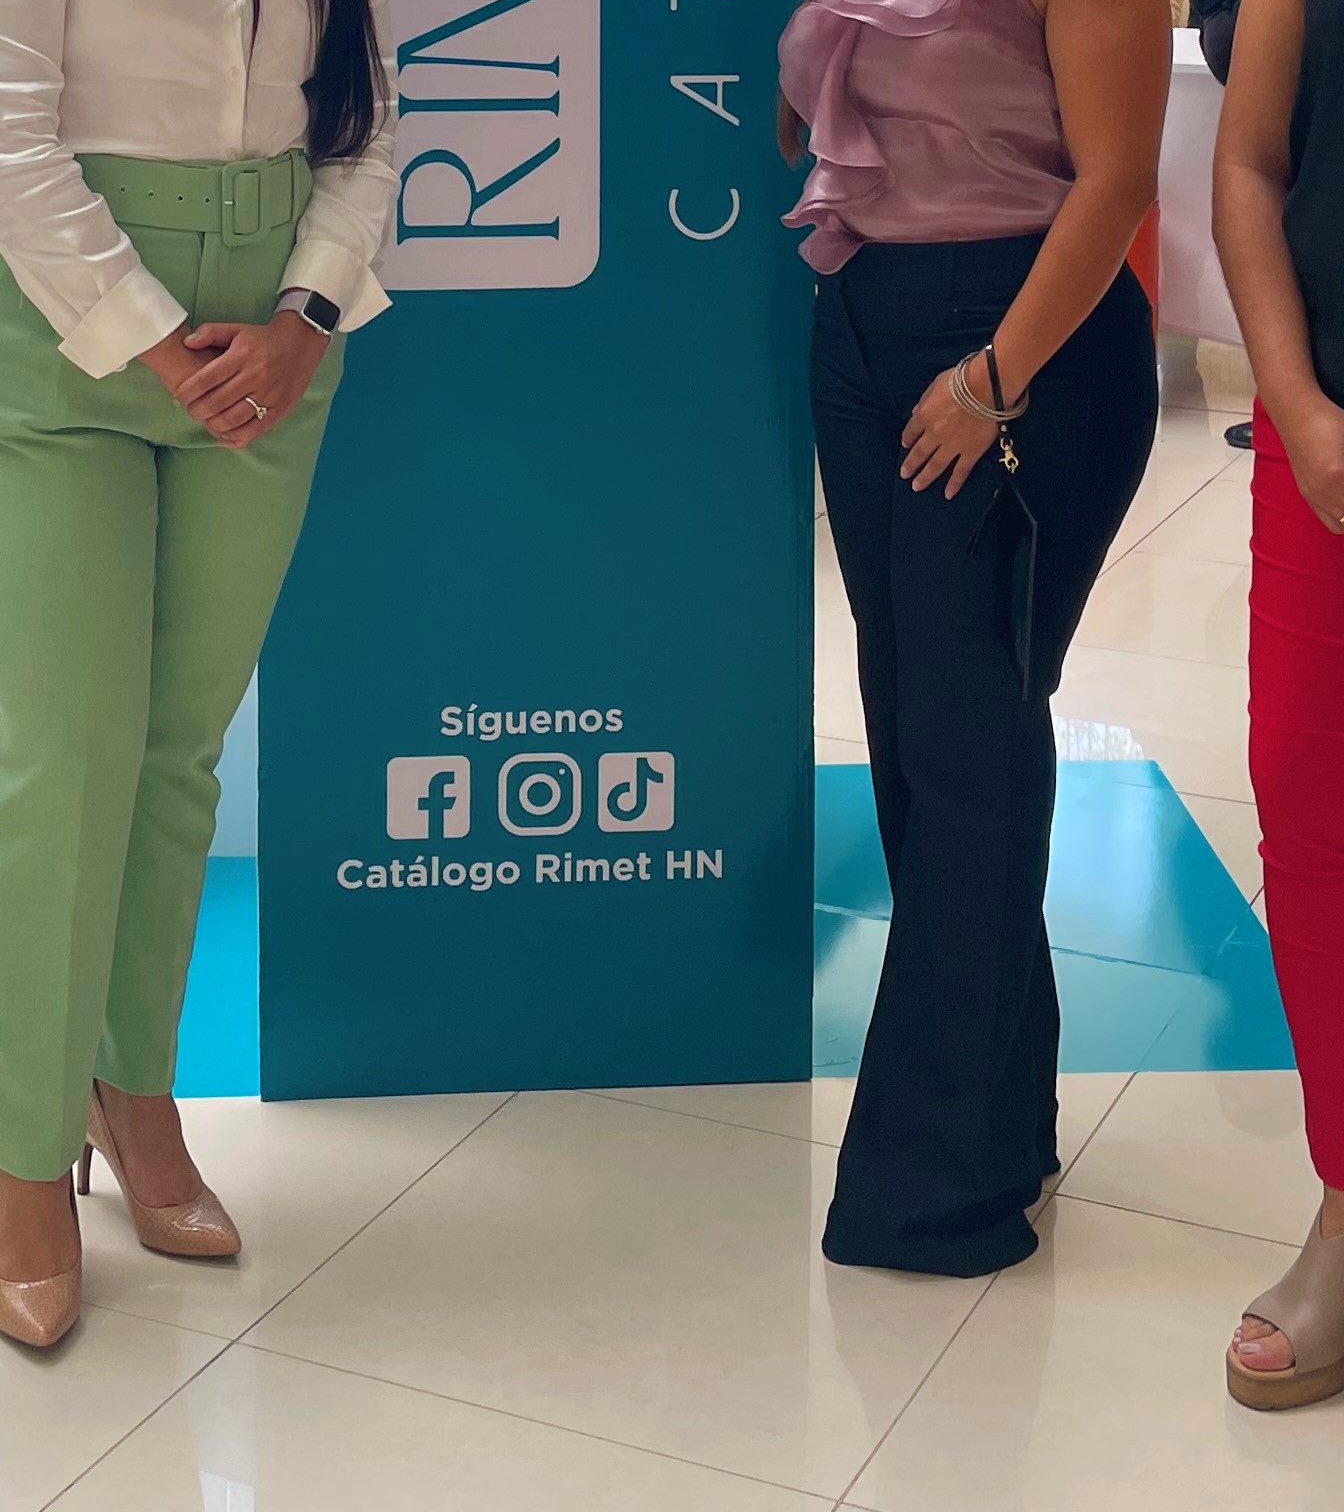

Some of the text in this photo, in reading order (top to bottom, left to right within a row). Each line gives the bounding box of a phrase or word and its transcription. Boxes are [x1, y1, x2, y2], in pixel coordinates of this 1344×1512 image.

[440, 704, 624, 742] Síguenos
[336, 849, 723, 892] Catálogo Rimet HN
